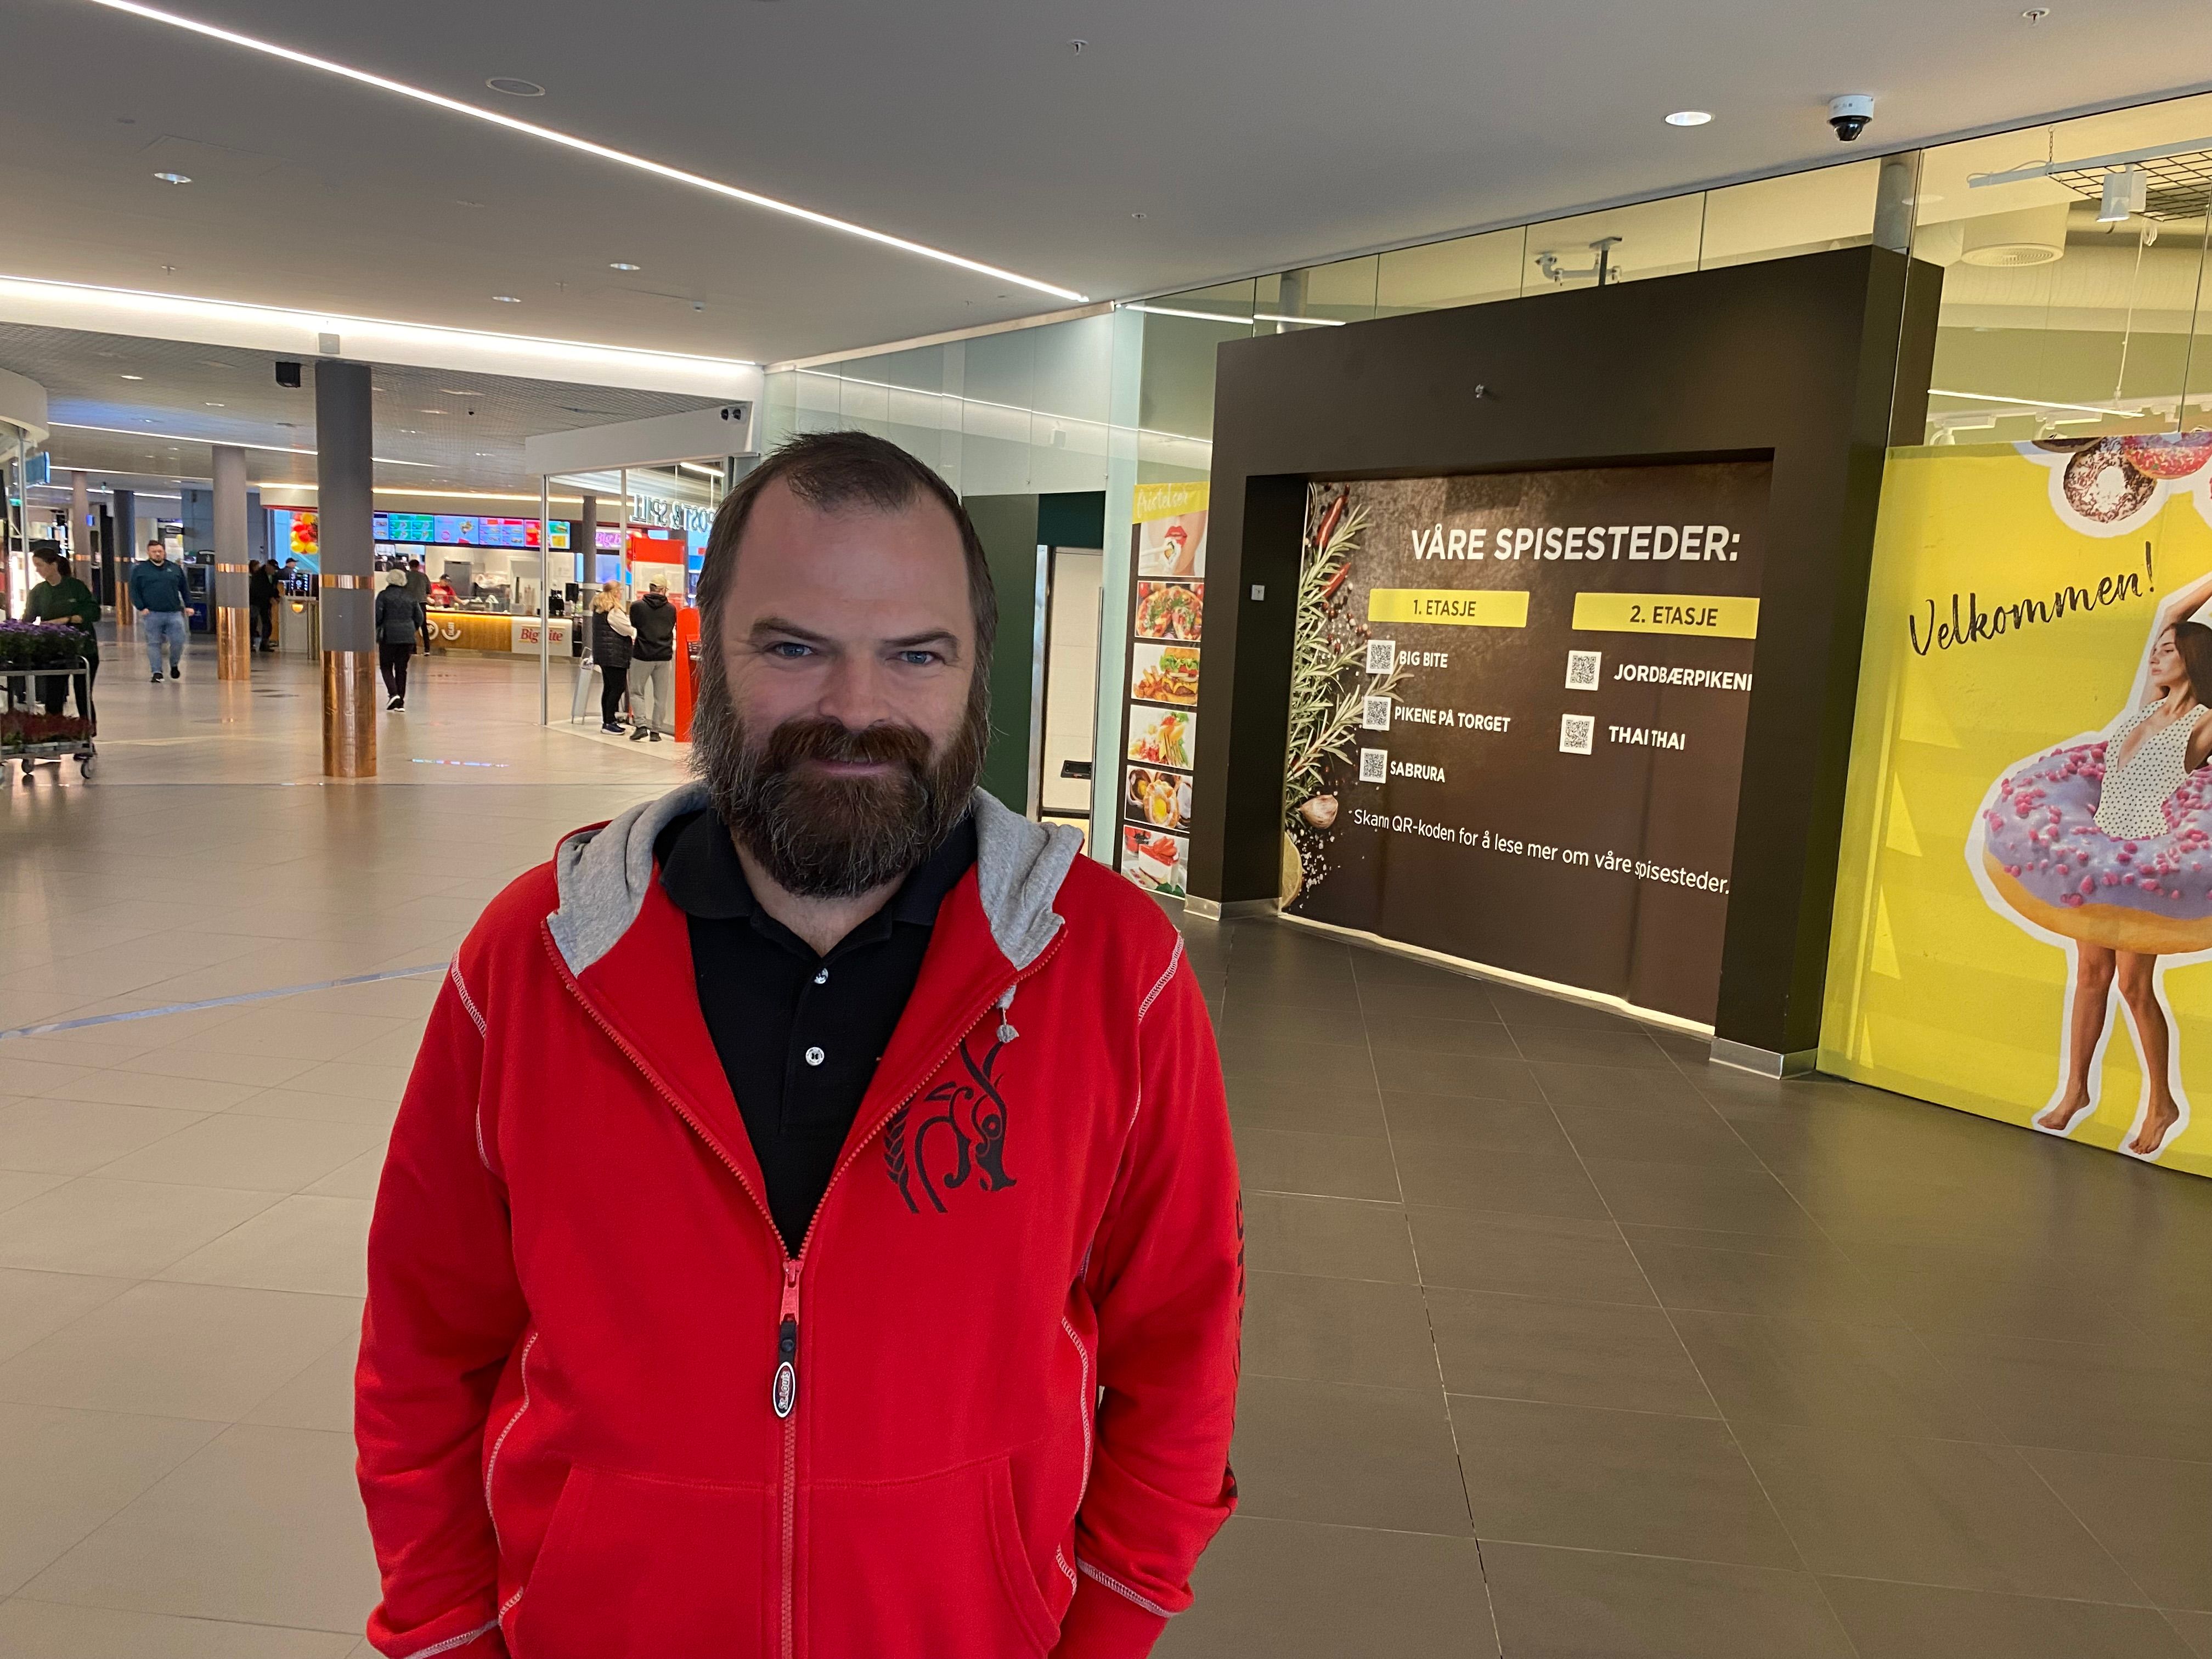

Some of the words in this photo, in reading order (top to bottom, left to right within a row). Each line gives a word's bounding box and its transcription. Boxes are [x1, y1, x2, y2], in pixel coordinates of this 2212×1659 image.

[1411, 523, 1486, 560] VÅRE
[1493, 526, 1740, 561] SPISESTEDER:
[1413, 600, 1423, 615] 1.
[1426, 600, 1476, 617] ETASJE
[1909, 540, 2155, 656] Velkommen!
[1630, 605, 1645, 623] 2.
[1652, 606, 1718, 627] ETASJE
[521, 628, 540, 644] Big
[1399, 651, 1420, 666] BIG
[1423, 652, 1448, 668] BITE
[1395, 706, 1437, 725] PIKENE
[1438, 709, 1454, 727] PÅ
[1457, 712, 1511, 733] TORGET
[1609, 725, 1649, 746] THAI
[1651, 730, 1686, 751] THAI
[1390, 760, 1446, 783] SABRURA
[1354, 809, 1389, 829] Skann
[1392, 815, 1455, 842] QR-koden
[1459, 827, 1479, 847] for
[1481, 830, 1490, 849] å
[1494, 833, 1523, 855] lese
[1527, 843, 1559, 861] mer
[1562, 849, 1589, 866] om
[1594, 850, 1632, 873] våre
[1634, 860, 1730, 895] spisesteder.
